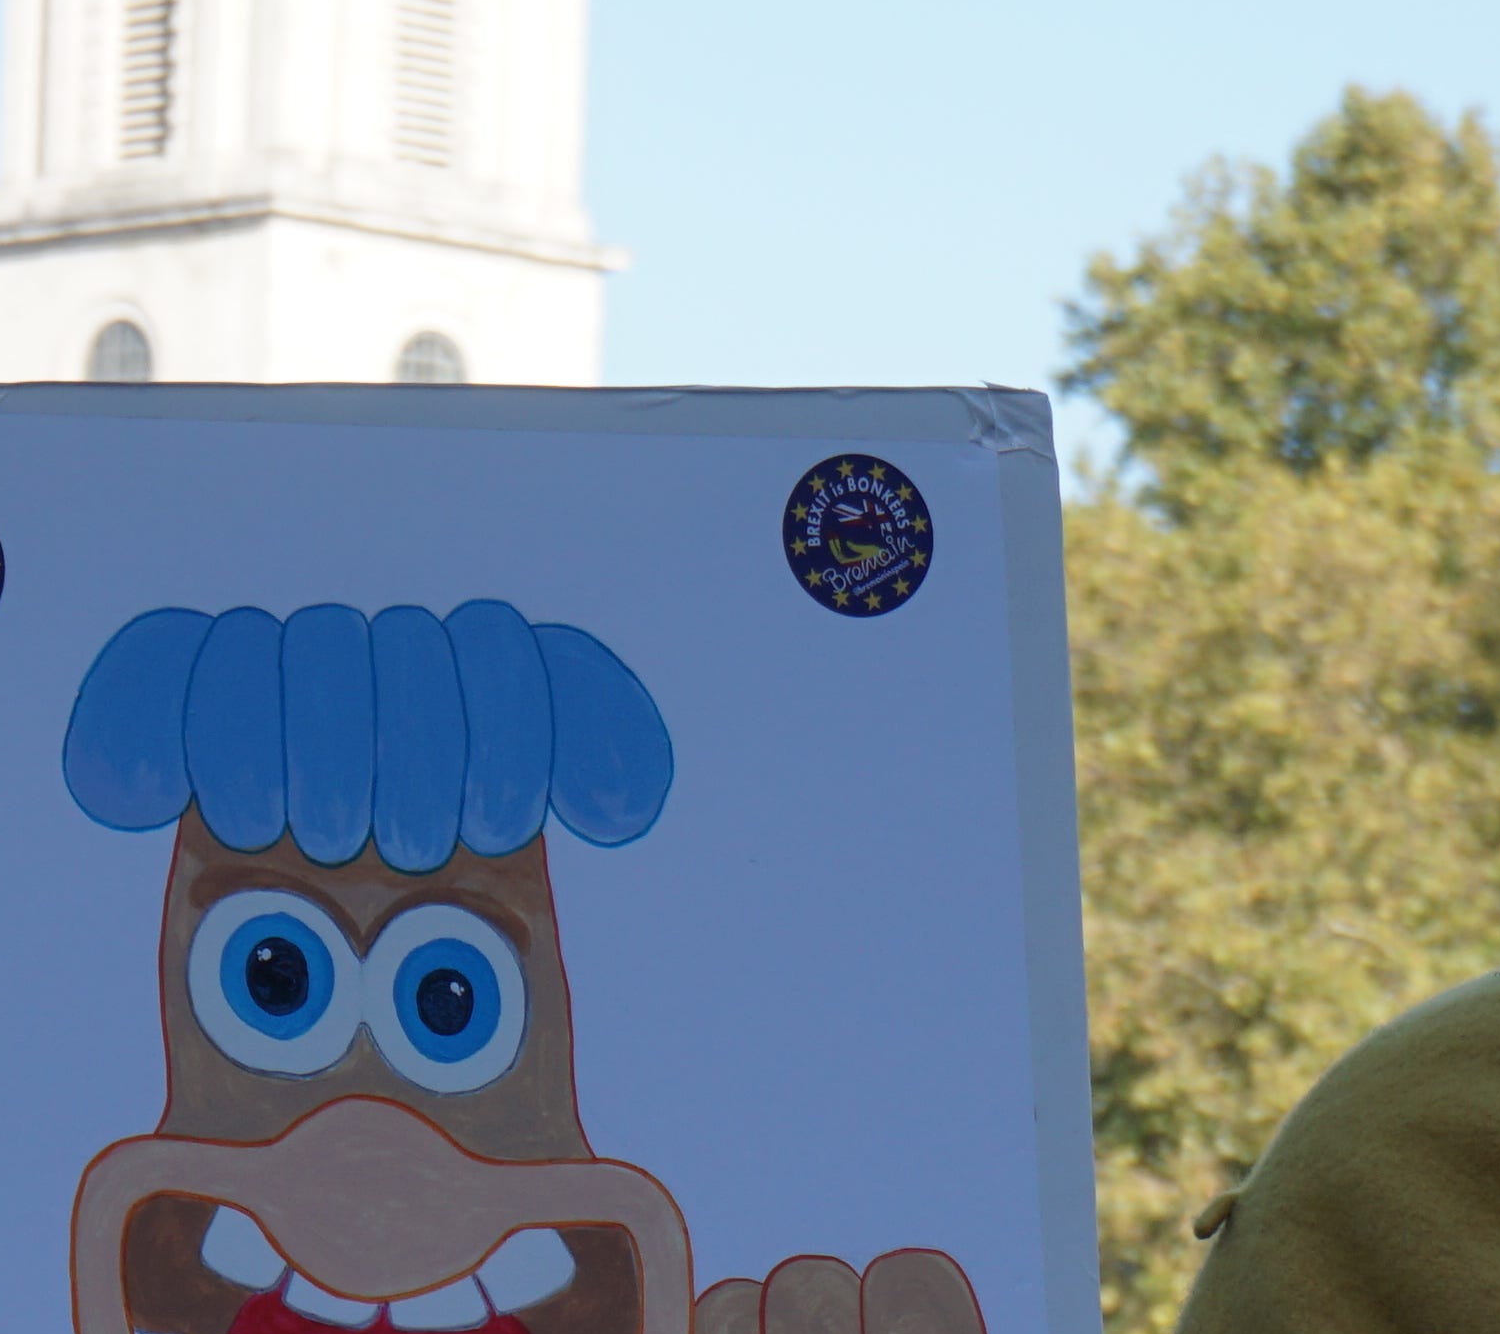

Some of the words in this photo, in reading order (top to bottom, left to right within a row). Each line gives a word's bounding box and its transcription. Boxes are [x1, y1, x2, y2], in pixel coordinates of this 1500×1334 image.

[807, 489, 832, 547] BREXIT
[829, 481, 844, 498] is
[847, 477, 911, 530] BONKERS
[822, 536, 915, 593] Bremain
